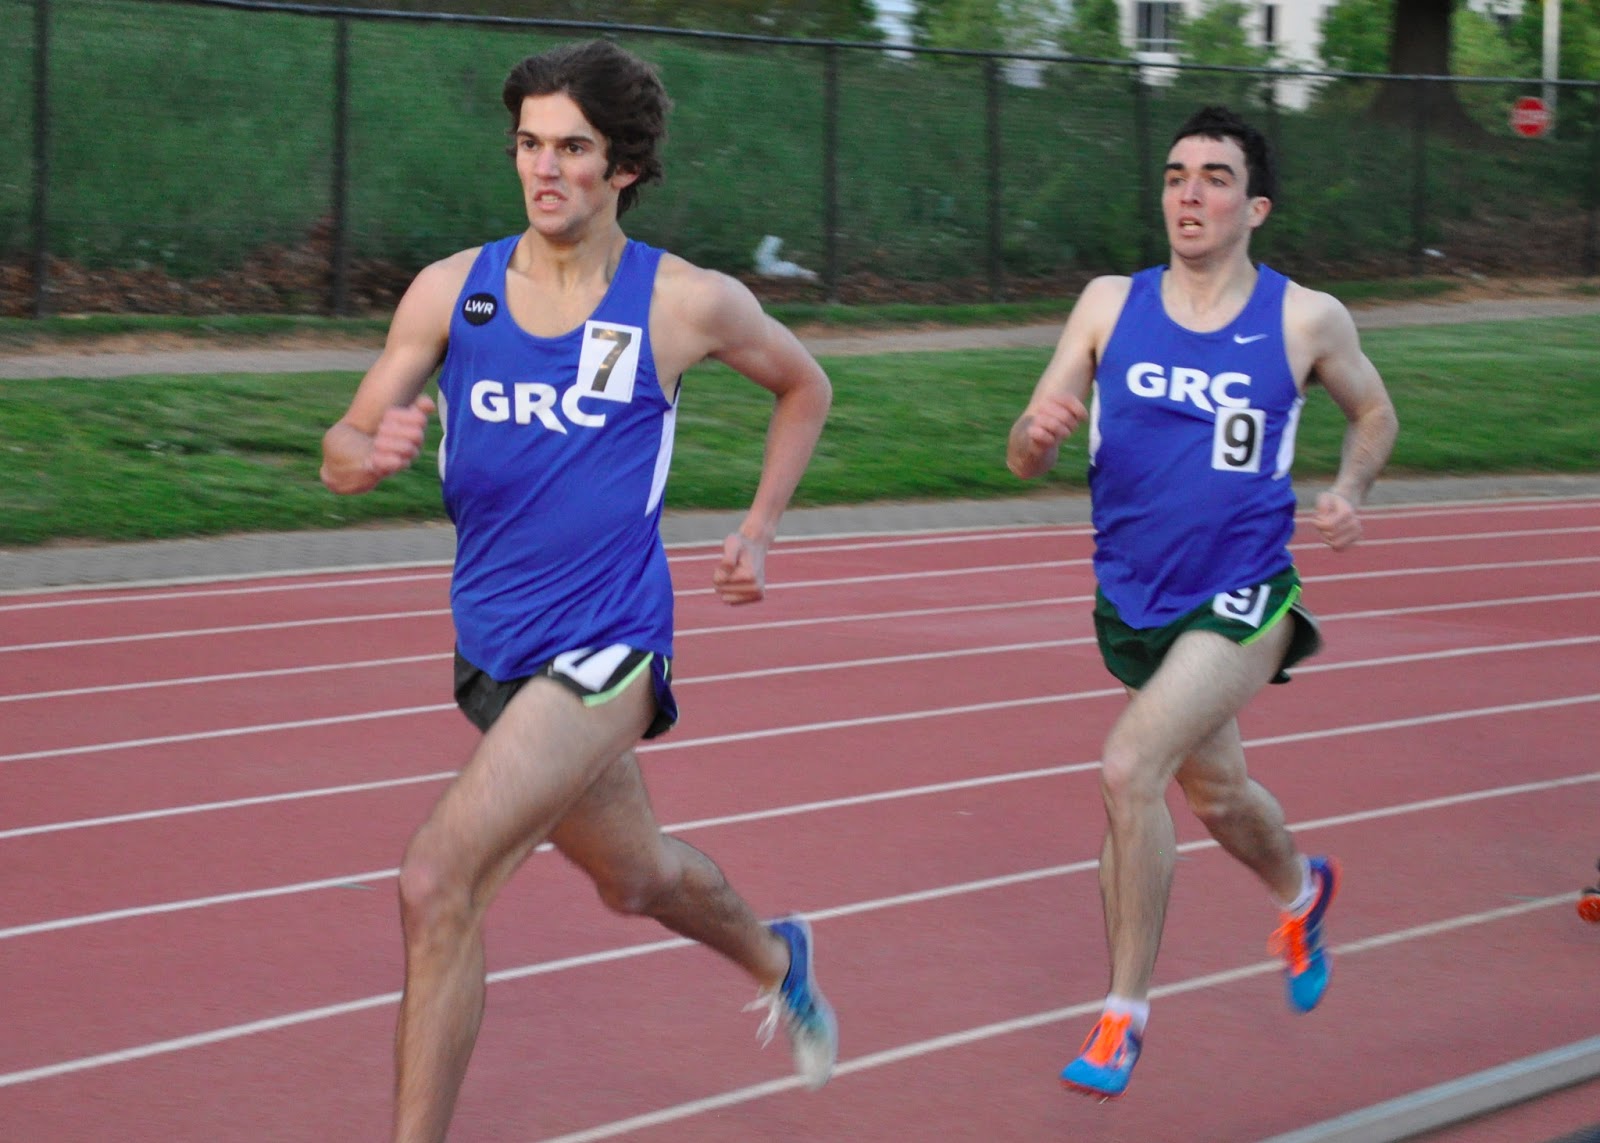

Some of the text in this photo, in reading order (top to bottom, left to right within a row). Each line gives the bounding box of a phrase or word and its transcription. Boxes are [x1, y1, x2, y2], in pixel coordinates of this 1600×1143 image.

[464, 299, 494, 315] LWR
[591, 327, 633, 393] 7
[1126, 361, 1252, 414] GRC
[470, 379, 607, 435] GRC
[1223, 412, 1256, 468] 9
